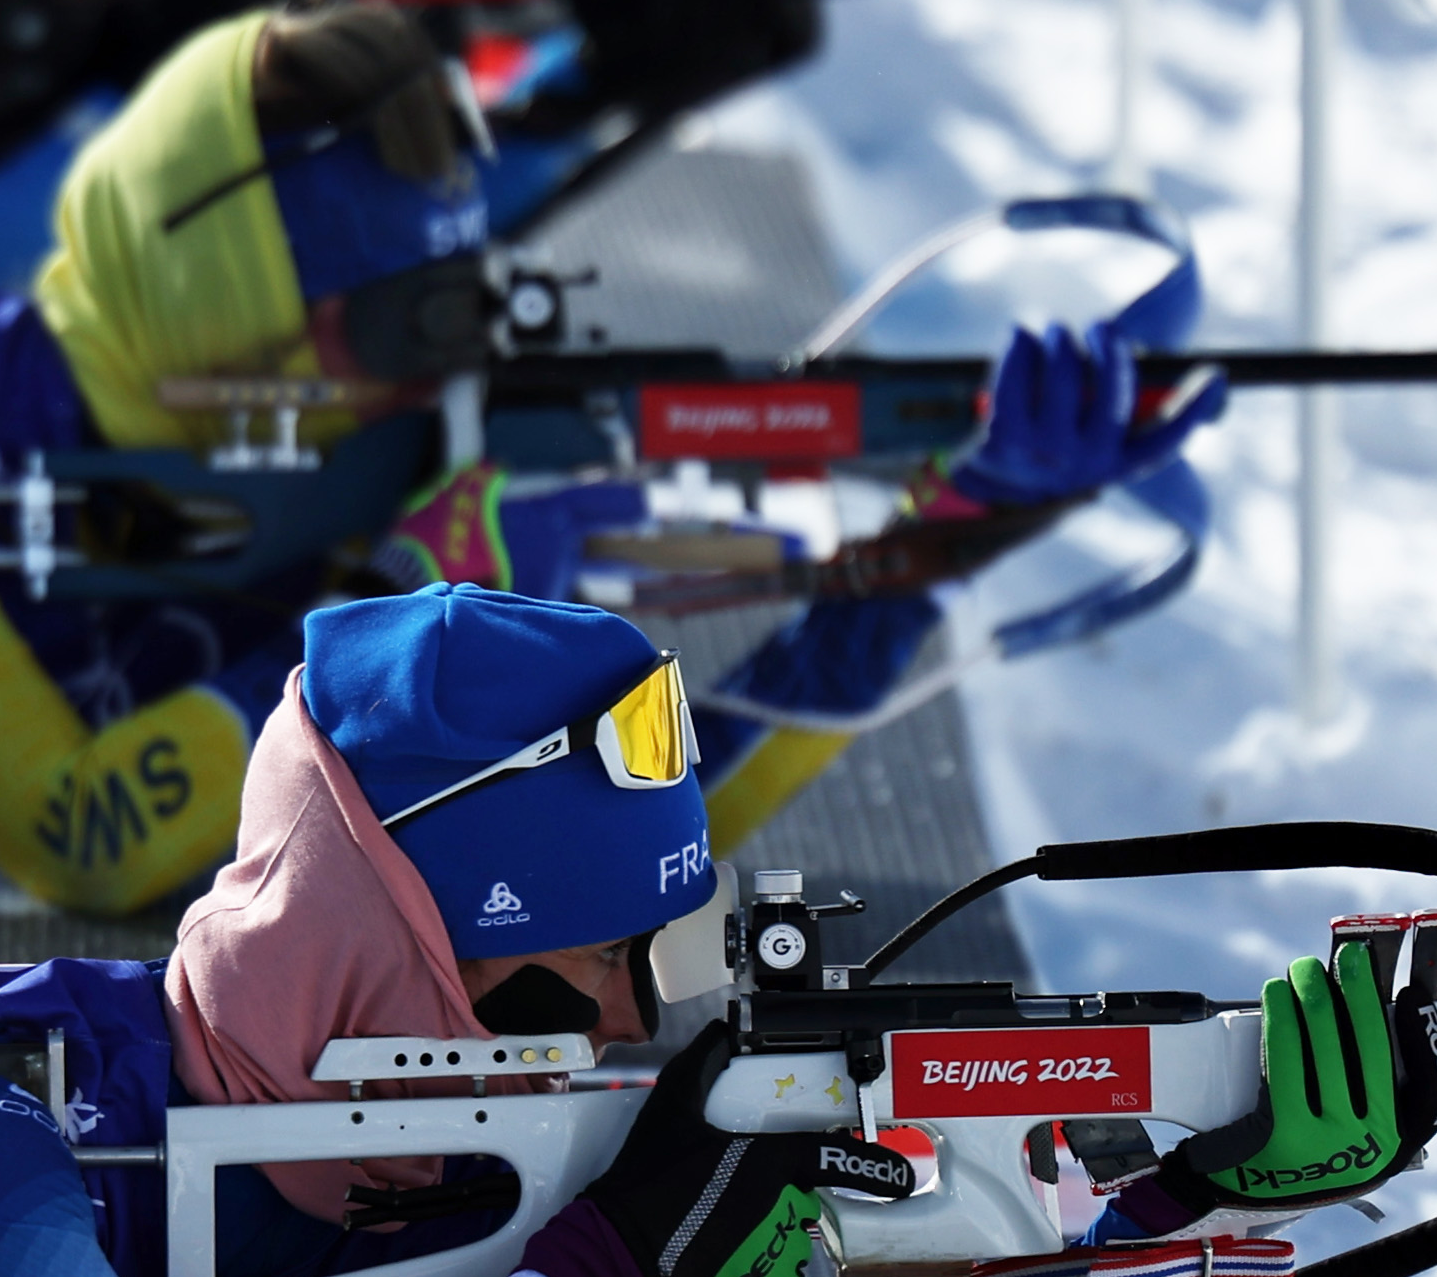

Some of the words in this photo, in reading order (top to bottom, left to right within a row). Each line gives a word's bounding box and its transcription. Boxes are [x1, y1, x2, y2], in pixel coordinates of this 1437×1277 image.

[921, 1059, 1029, 1092] BEIJING
[1037, 1057, 1119, 1083] 2022
[1111, 1092, 1138, 1107] RCS
